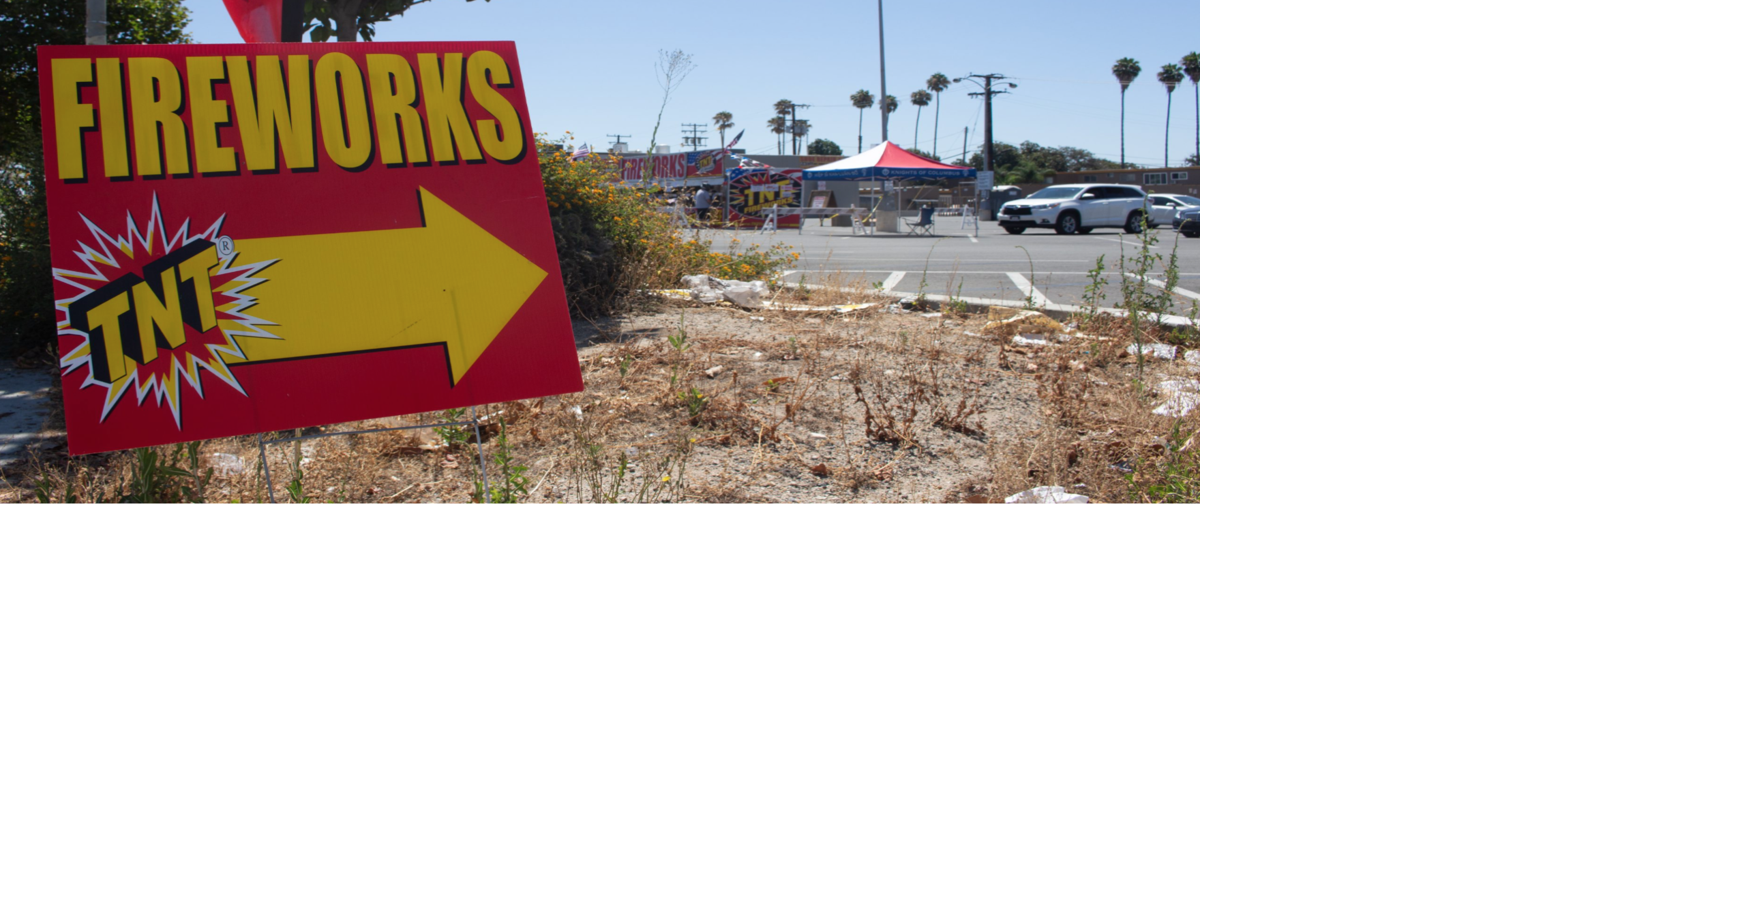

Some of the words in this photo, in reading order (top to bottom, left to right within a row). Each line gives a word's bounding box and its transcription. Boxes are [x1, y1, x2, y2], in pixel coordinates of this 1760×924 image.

[51, 50, 526, 182] FIREWORKS
[744, 179, 790, 207] TNT
[744, 198, 793, 214] FIREWORKS
[86, 244, 219, 384] TNT
